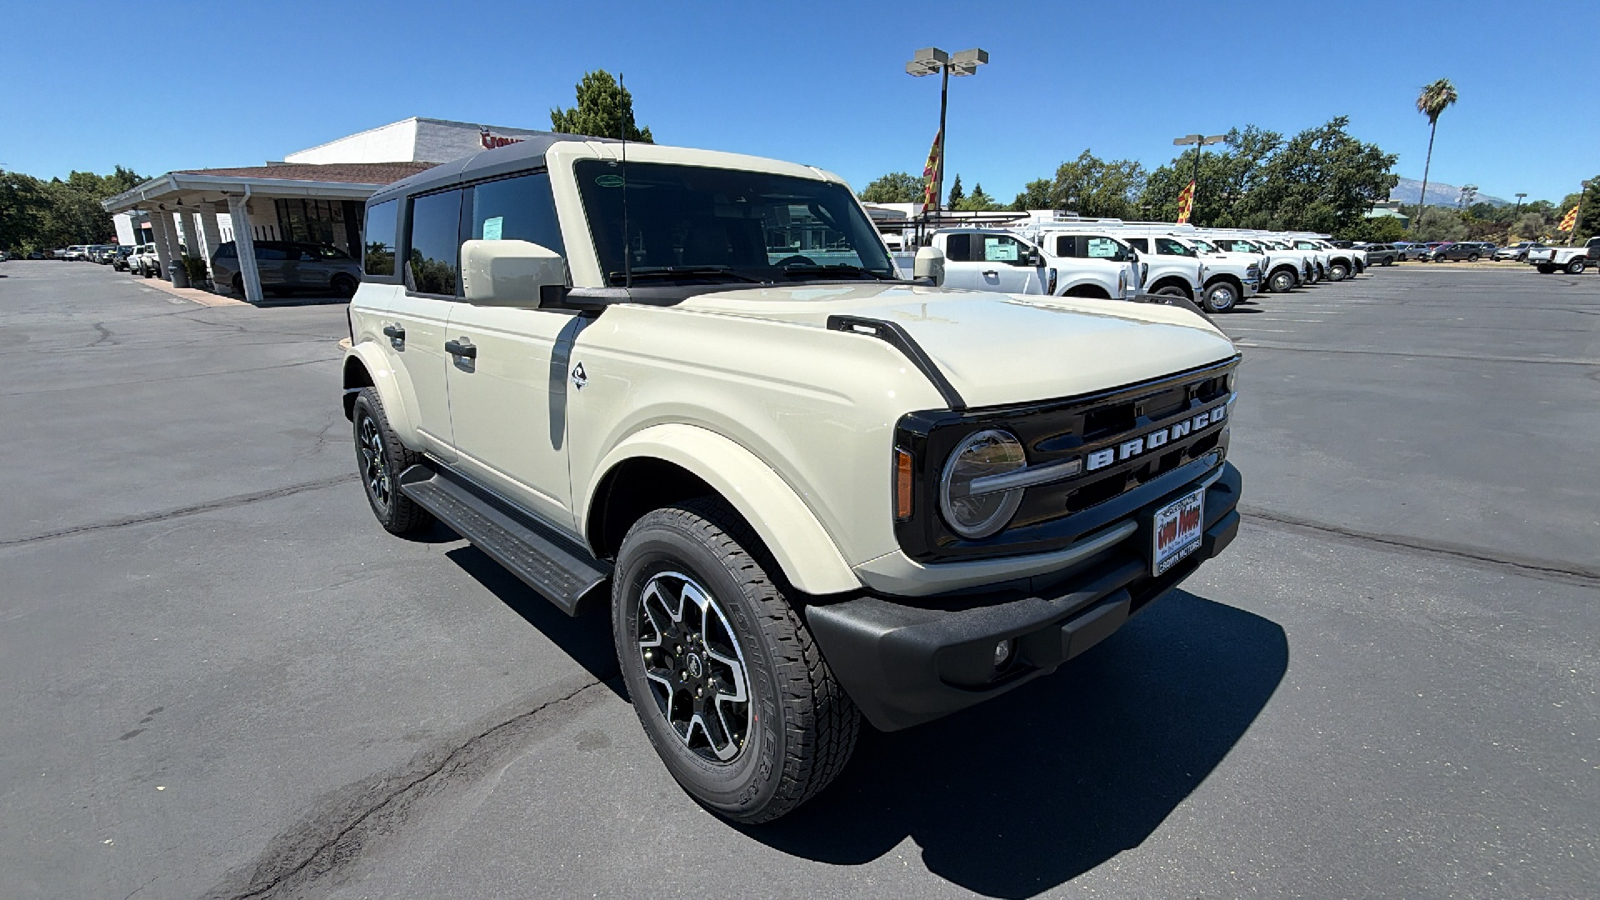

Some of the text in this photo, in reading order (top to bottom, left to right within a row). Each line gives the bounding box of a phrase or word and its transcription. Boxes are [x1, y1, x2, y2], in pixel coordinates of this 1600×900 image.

[1087, 404, 1227, 471] BRONCO
[1159, 553, 1179, 573] CROWN
[1179, 540, 1200, 560] MOTORS
